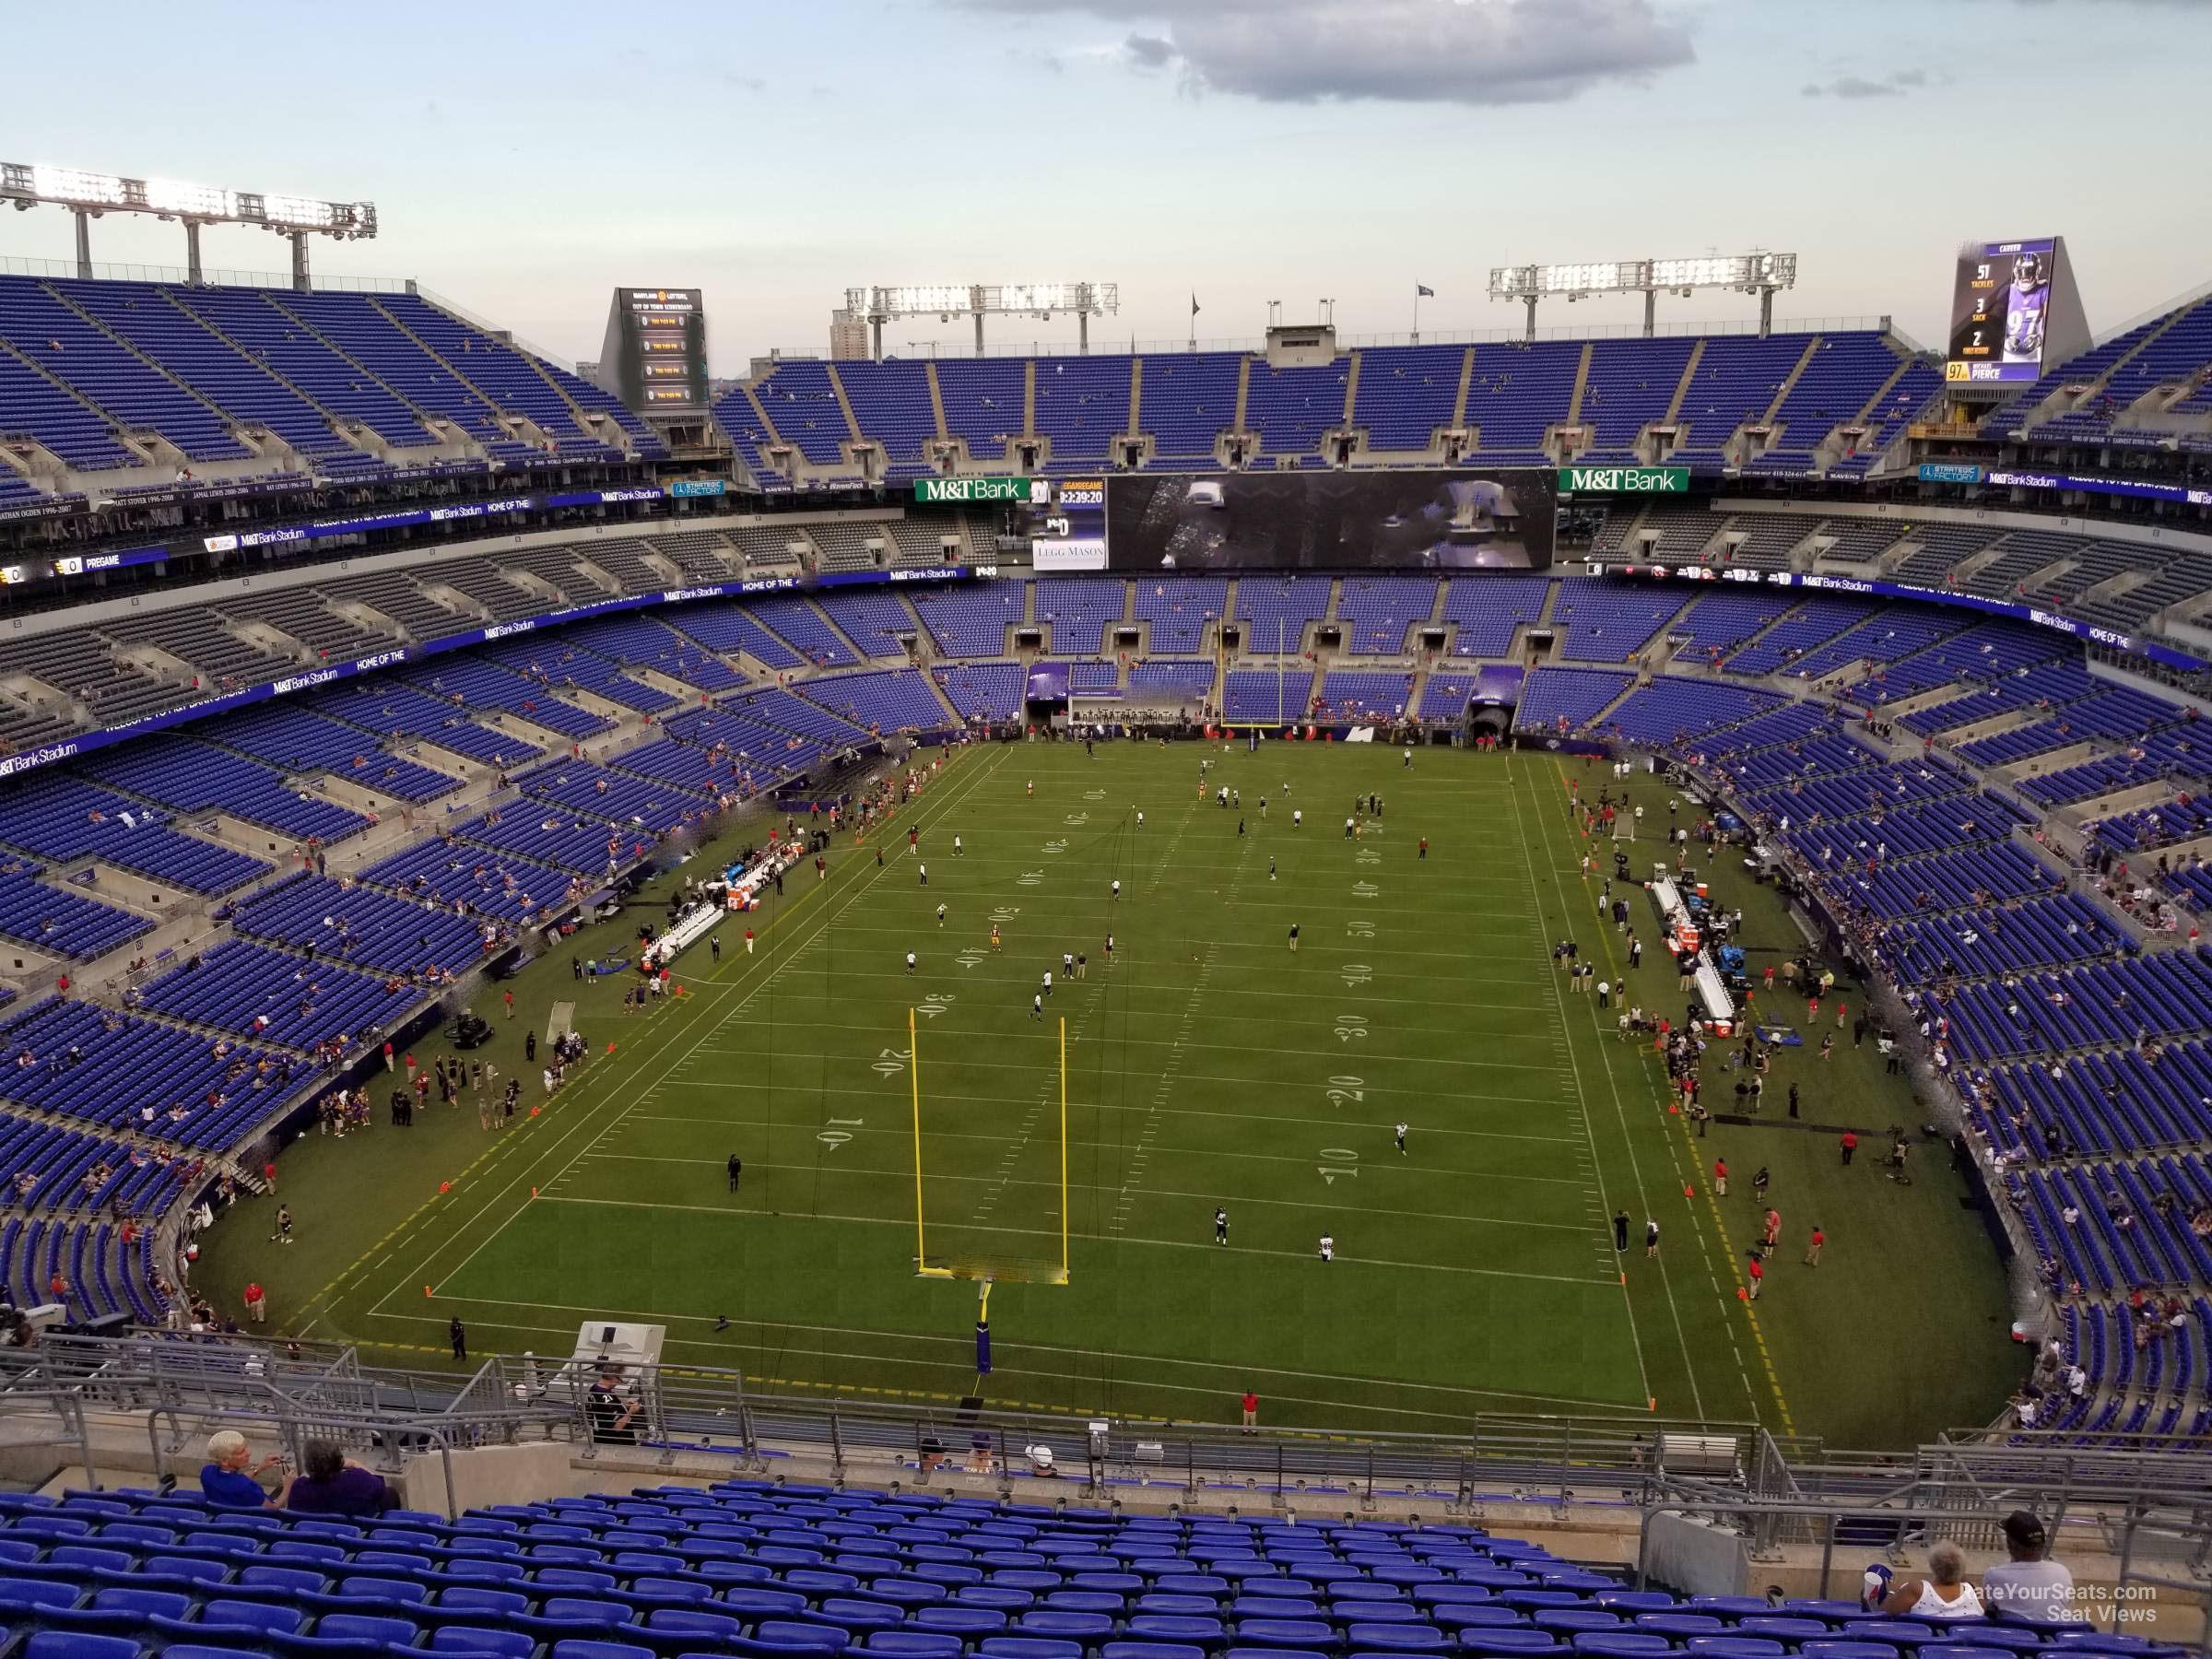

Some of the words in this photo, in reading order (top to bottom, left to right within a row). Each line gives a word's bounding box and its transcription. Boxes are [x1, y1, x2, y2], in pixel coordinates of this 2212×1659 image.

[1977, 265, 1990, 279] 51
[1976, 299, 1984, 312] 3
[2007, 310, 2041, 335] 97
[1973, 332, 1982, 346] 2
[1949, 364, 1962, 378] 97
[1972, 369, 2001, 380] PIERCE
[1571, 470, 1624, 490] M&T
[1625, 469, 1675, 490] Bank
[1989, 472, 2007, 484] M&T
[2007, 474, 2026, 486] Bank
[2026, 474, 2056, 488] Stadium
[602, 491, 618, 502] M&T
[618, 490, 635, 500] Bank
[635, 489, 661, 500] Stadium
[925, 480, 974, 500] M&T
[975, 479, 1019, 499] Bank
[2187, 489, 2203, 503] M&T
[20, 508, 41, 517] OGDEN
[430, 510, 445, 521] M&T
[444, 509, 460, 519] Bank
[459, 506, 482, 518] Stadium
[488, 501, 505, 512] HOME
[506, 500, 515, 510] OF
[516, 500, 529, 509] THE
[241, 534, 259, 547] M&T
[259, 532, 276, 544] Bank
[276, 529, 305, 542] Stadium
[1068, 547, 1103, 556] MASON
[69, 560, 76, 571] 0
[86, 555, 120, 569] PREGAME
[890, 571, 910, 581] M&T
[910, 570, 927, 579] Bank
[926, 569, 957, 578] Stadium
[1802, 574, 1823, 586] M&T
[1823, 577, 1843, 589] Bank
[1842, 579, 1873, 593] Stadium
[664, 591, 681, 602] M&T
[680, 588, 697, 599] Bank
[697, 586, 723, 598] Stadium
[743, 581, 765, 591] HOME
[766, 580, 777, 589] OF
[777, 579, 793, 588] THE
[485, 628, 500, 640] M&T
[500, 625, 514, 637] Bank
[513, 620, 535, 632] Stadium
[2030, 609, 2043, 623] M&T
[2042, 613, 2056, 627] Bank
[2055, 616, 2077, 633] Stadium
[2088, 627, 2107, 642] HOME
[2107, 631, 2116, 643] OF
[2116, 635, 2129, 648] THE
[273, 678, 292, 695] M&T
[292, 675, 311, 689] Bank
[310, 669, 338, 685] Stadium
[357, 658, 378, 672] HOME
[378, 653, 389, 665] OF
[389, 650, 406, 662] THE
[15, 754, 39, 771] Bank
[39, 743, 77, 764] Stadium
[1355, 852, 1382, 864] 30
[1351, 884, 1379, 898] 40
[988, 907, 1020, 922] 50
[1347, 921, 1375, 937] 50
[1341, 965, 1372, 983] 40
[917, 994, 956, 1014] 30
[1335, 1016, 1369, 1037] 30
[871, 1048, 912, 1072] 20
[1326, 1076, 1364, 1101] 20
[817, 1117, 864, 1143] 10
[1317, 1148, 1359, 1178] 10
